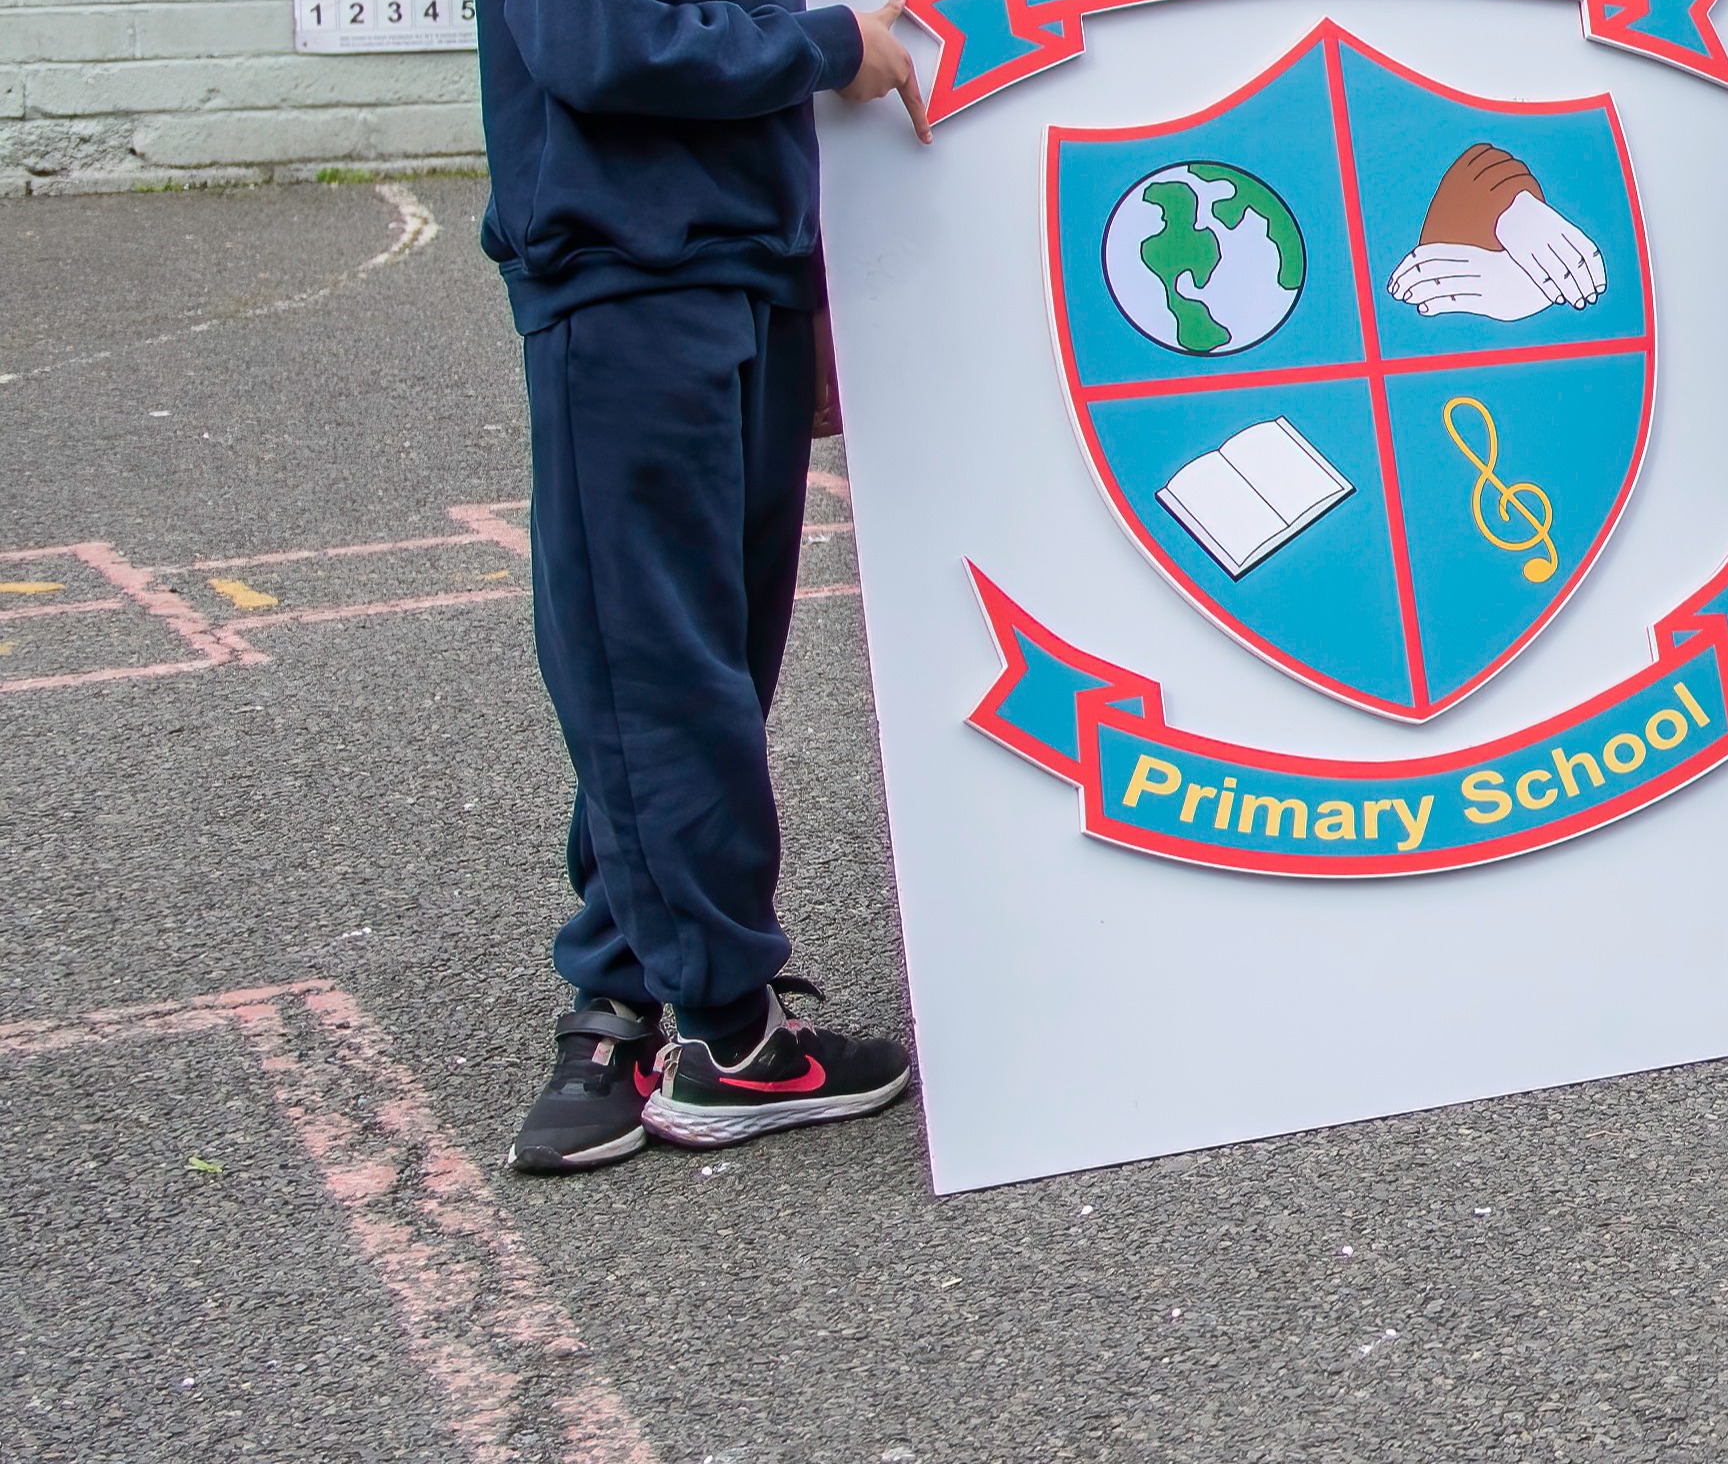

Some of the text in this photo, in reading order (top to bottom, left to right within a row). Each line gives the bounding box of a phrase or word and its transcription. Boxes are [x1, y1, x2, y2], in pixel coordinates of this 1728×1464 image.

[310, 0, 476, 26] 1 2 3 4 5
[1122, 682, 1712, 852] Primary School
